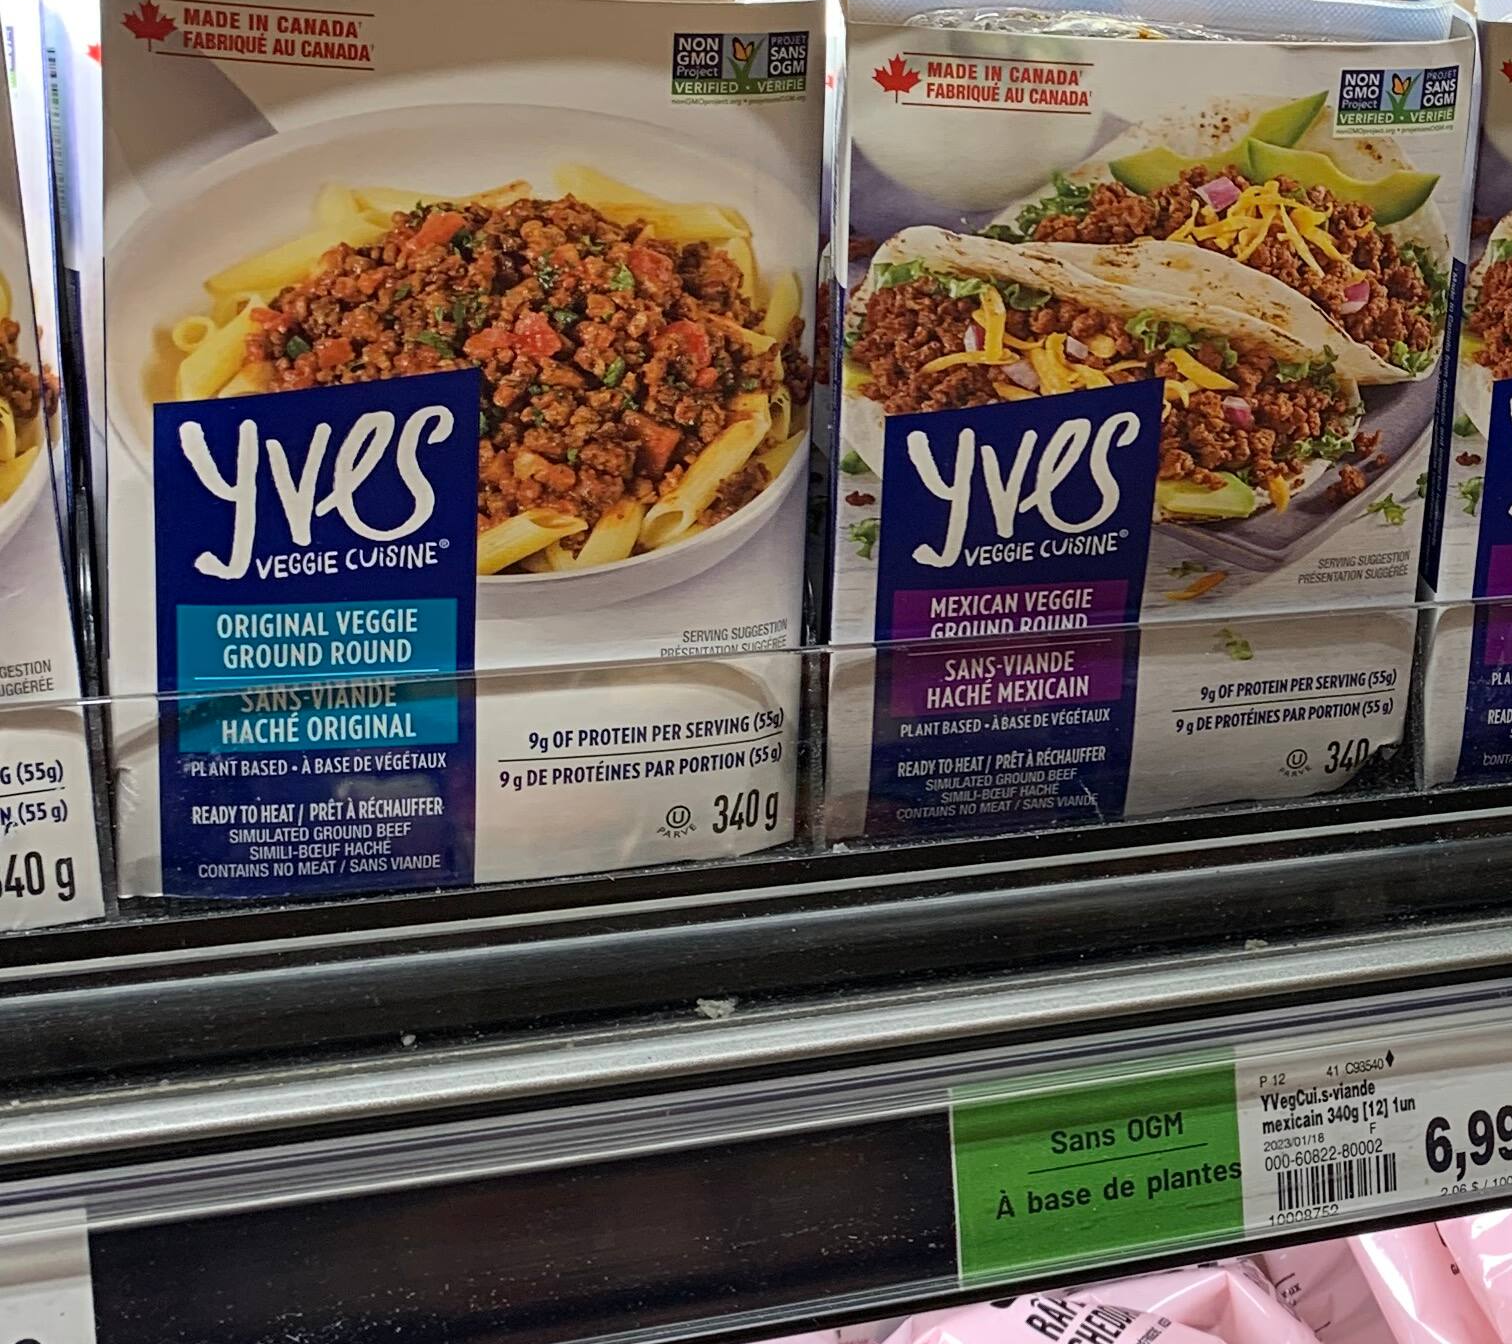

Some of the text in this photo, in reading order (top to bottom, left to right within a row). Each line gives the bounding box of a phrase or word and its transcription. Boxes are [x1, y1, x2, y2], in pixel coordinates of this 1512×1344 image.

[184, 8, 241, 29] MADE
[249, 14, 269, 32] IN
[1342, 86, 1380, 101] GMO
[1343, 72, 1380, 87] NON
[1338, 111, 1394, 125] VERIFIED
[930, 587, 1094, 619] MEXICAN VEGGIE
[216, 607, 418, 641] ORIGINAL VEGGIE
[223, 639, 412, 670] GROUND ROUND
[944, 650, 1076, 683] SANS-VIANDE
[926, 674, 1090, 710] HACHÉ MEXICAIN
[528, 707, 784, 753] 9g OF PROTEIN PER SERVING (55g)
[712, 788, 779, 835] 340 g
[228, 821, 412, 844] SIMULATED GROUND BEEF
[1050, 1111, 1183, 1155] Sans OGM
[1262, 1105, 1359, 1135] mexicain 340g
[1265, 1138, 1383, 1172] 000-60822-80002
[996, 1157, 1243, 1221] À base de plantes
